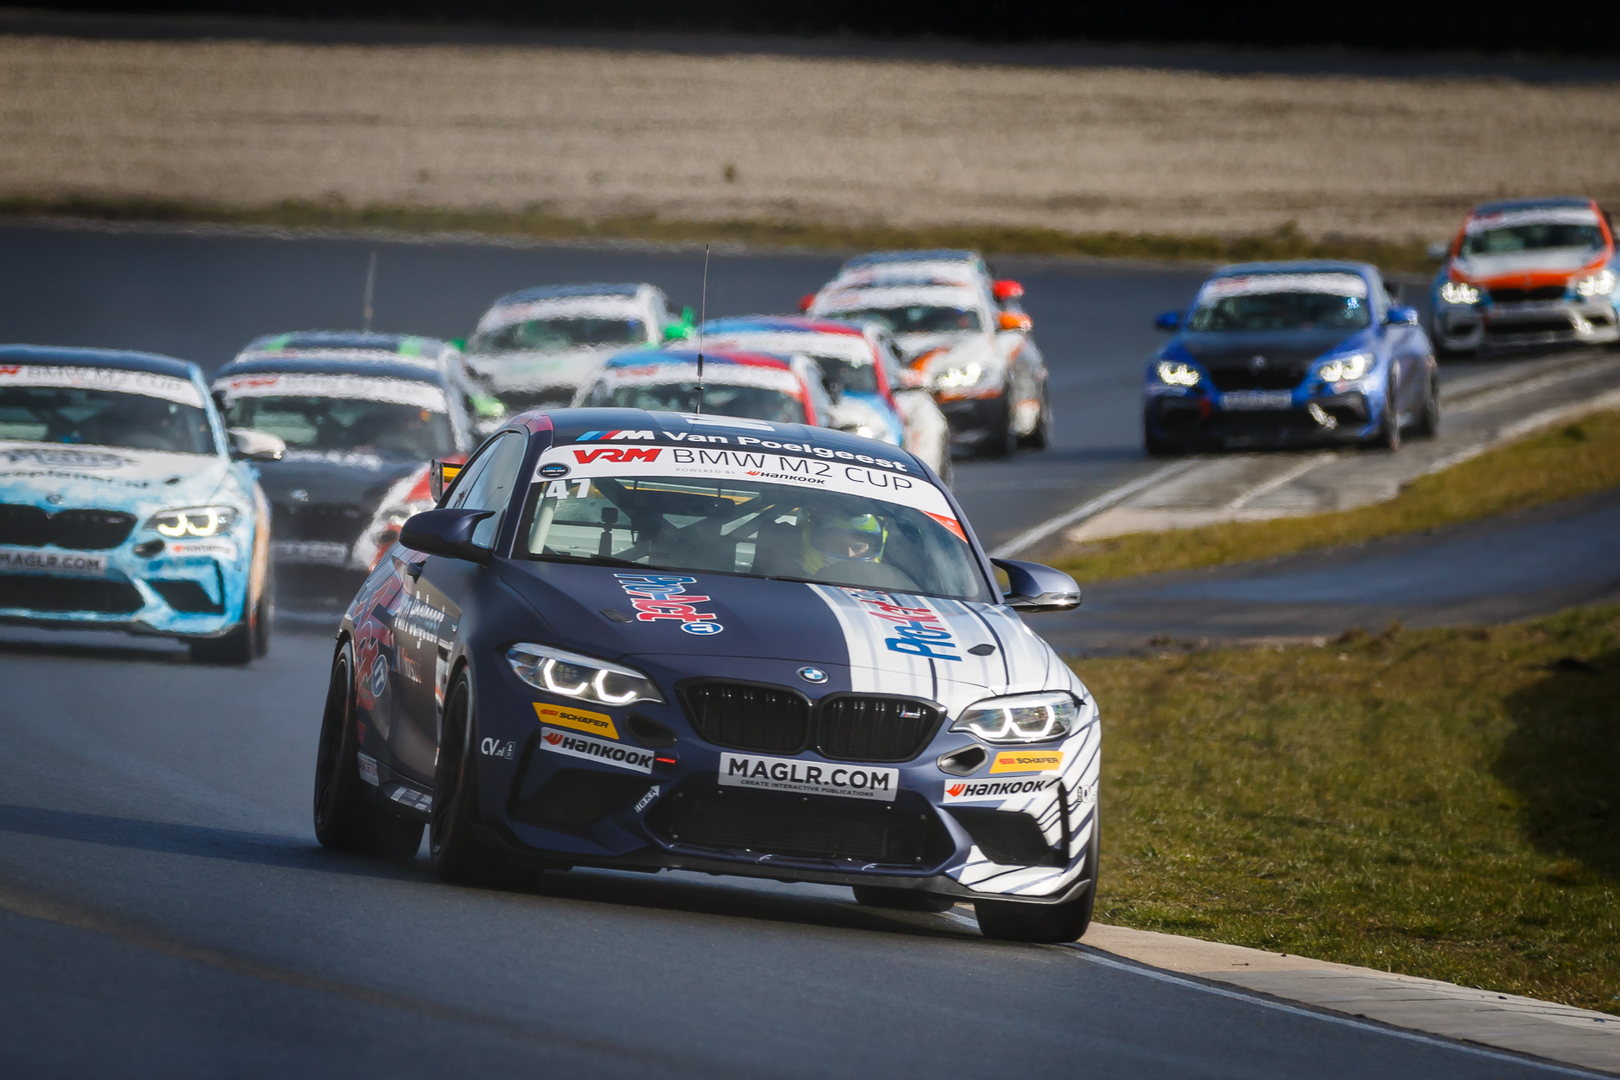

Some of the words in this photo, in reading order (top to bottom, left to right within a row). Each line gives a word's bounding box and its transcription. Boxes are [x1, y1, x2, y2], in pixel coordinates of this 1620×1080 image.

[662, 431, 728, 443] Van
[737, 436, 908, 472] Poelgeest
[573, 448, 662, 464] VRM
[673, 449, 765, 469] BMW
[779, 456, 833, 478] M2
[845, 466, 913, 490] CUP
[675, 467, 722, 475] POWERED
[545, 478, 591, 500] 47
[728, 757, 890, 791] MAGLR.COM
[740, 779, 771, 787] CREATE
[771, 782, 820, 792] INTERACTIVE
[821, 786, 875, 797] PUBLICATIONS
